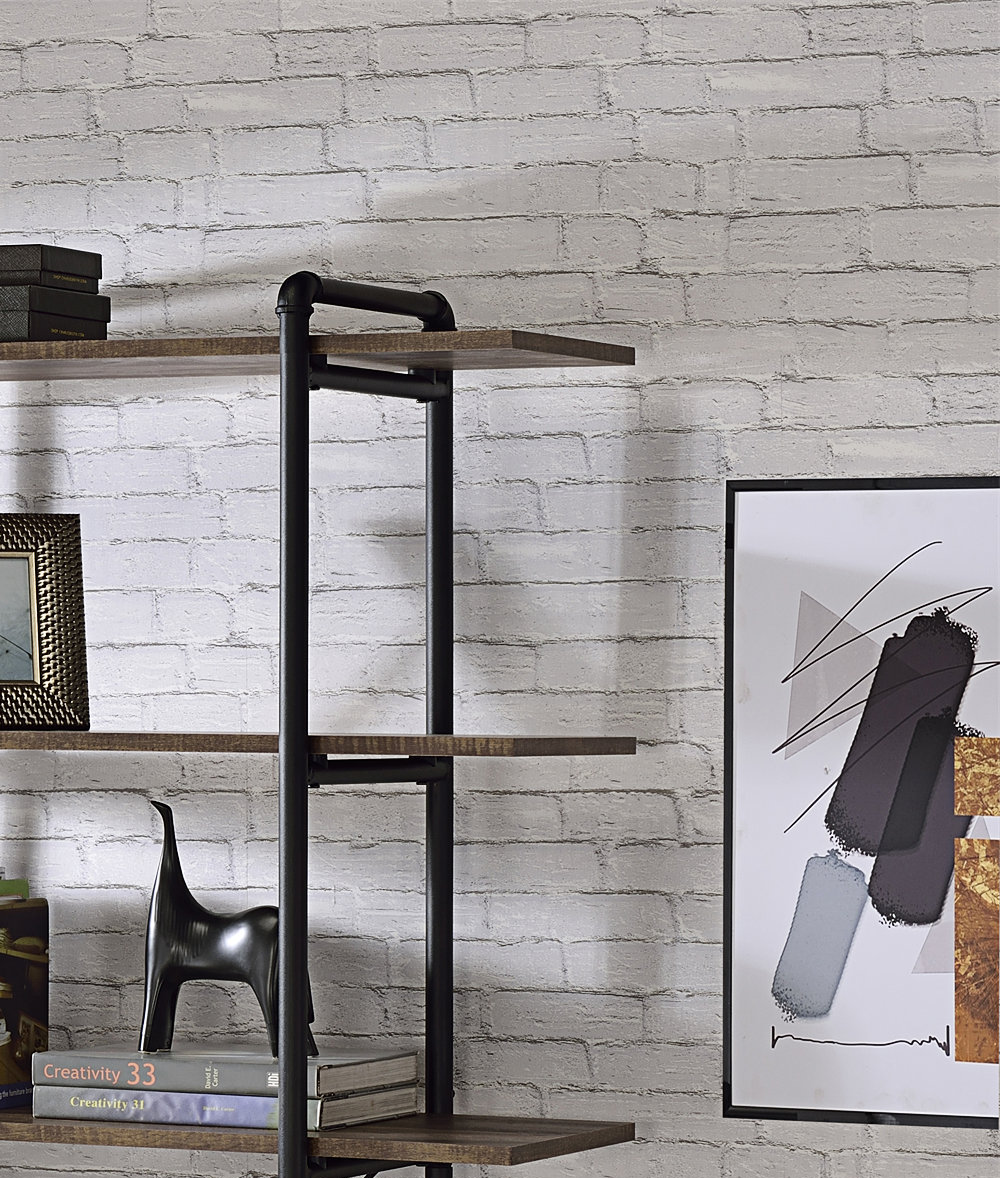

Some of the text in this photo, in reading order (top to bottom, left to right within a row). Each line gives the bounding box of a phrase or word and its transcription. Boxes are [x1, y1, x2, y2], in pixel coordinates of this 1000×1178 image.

[43, 1057, 156, 1086] Creativity 33
[204, 1073, 212, 1089] David
[70, 1096, 145, 1111] Creativity 31
